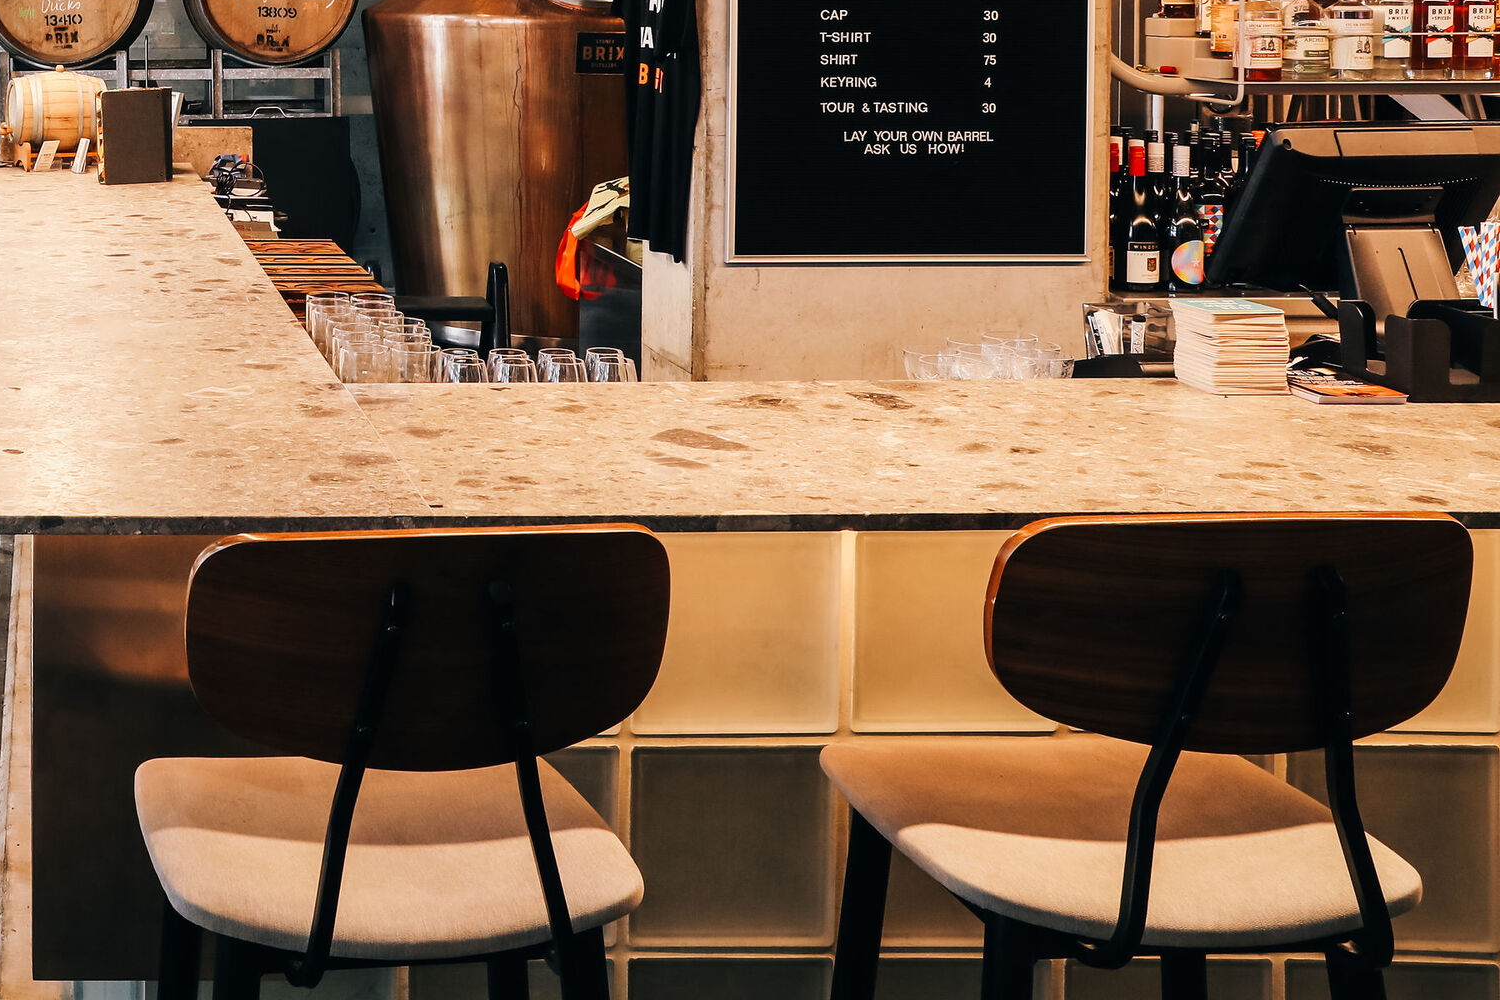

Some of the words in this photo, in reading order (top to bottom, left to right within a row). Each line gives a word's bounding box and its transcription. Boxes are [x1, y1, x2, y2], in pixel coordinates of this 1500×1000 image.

[258, 6, 297, 19] 13809
[820, 10, 848, 20] CAP
[983, 10, 999, 21] 30
[45, 14, 83, 26] 13410
[820, 32, 871, 43] T-SHIRT
[982, 32, 997, 43] 30
[583, 46, 625, 61] BRIX
[820, 55, 858, 66] SHIRT
[984, 55, 997, 66] 75
[820, 77, 877, 88] KEYRING
[984, 77, 991, 88] 4
[820, 102, 855, 113] TOUR
[862, 103, 870, 113] &
[873, 102, 928, 113] TASTING
[982, 103, 997, 113] 30
[844, 131, 867, 142] LAY
[874, 131, 908, 142] YOUR
[912, 131, 943, 142] OWN
[947, 130, 994, 142] BARREL
[864, 143, 891, 154] ASK
[900, 143, 917, 154] US
[928, 143, 965, 154] HOW!
